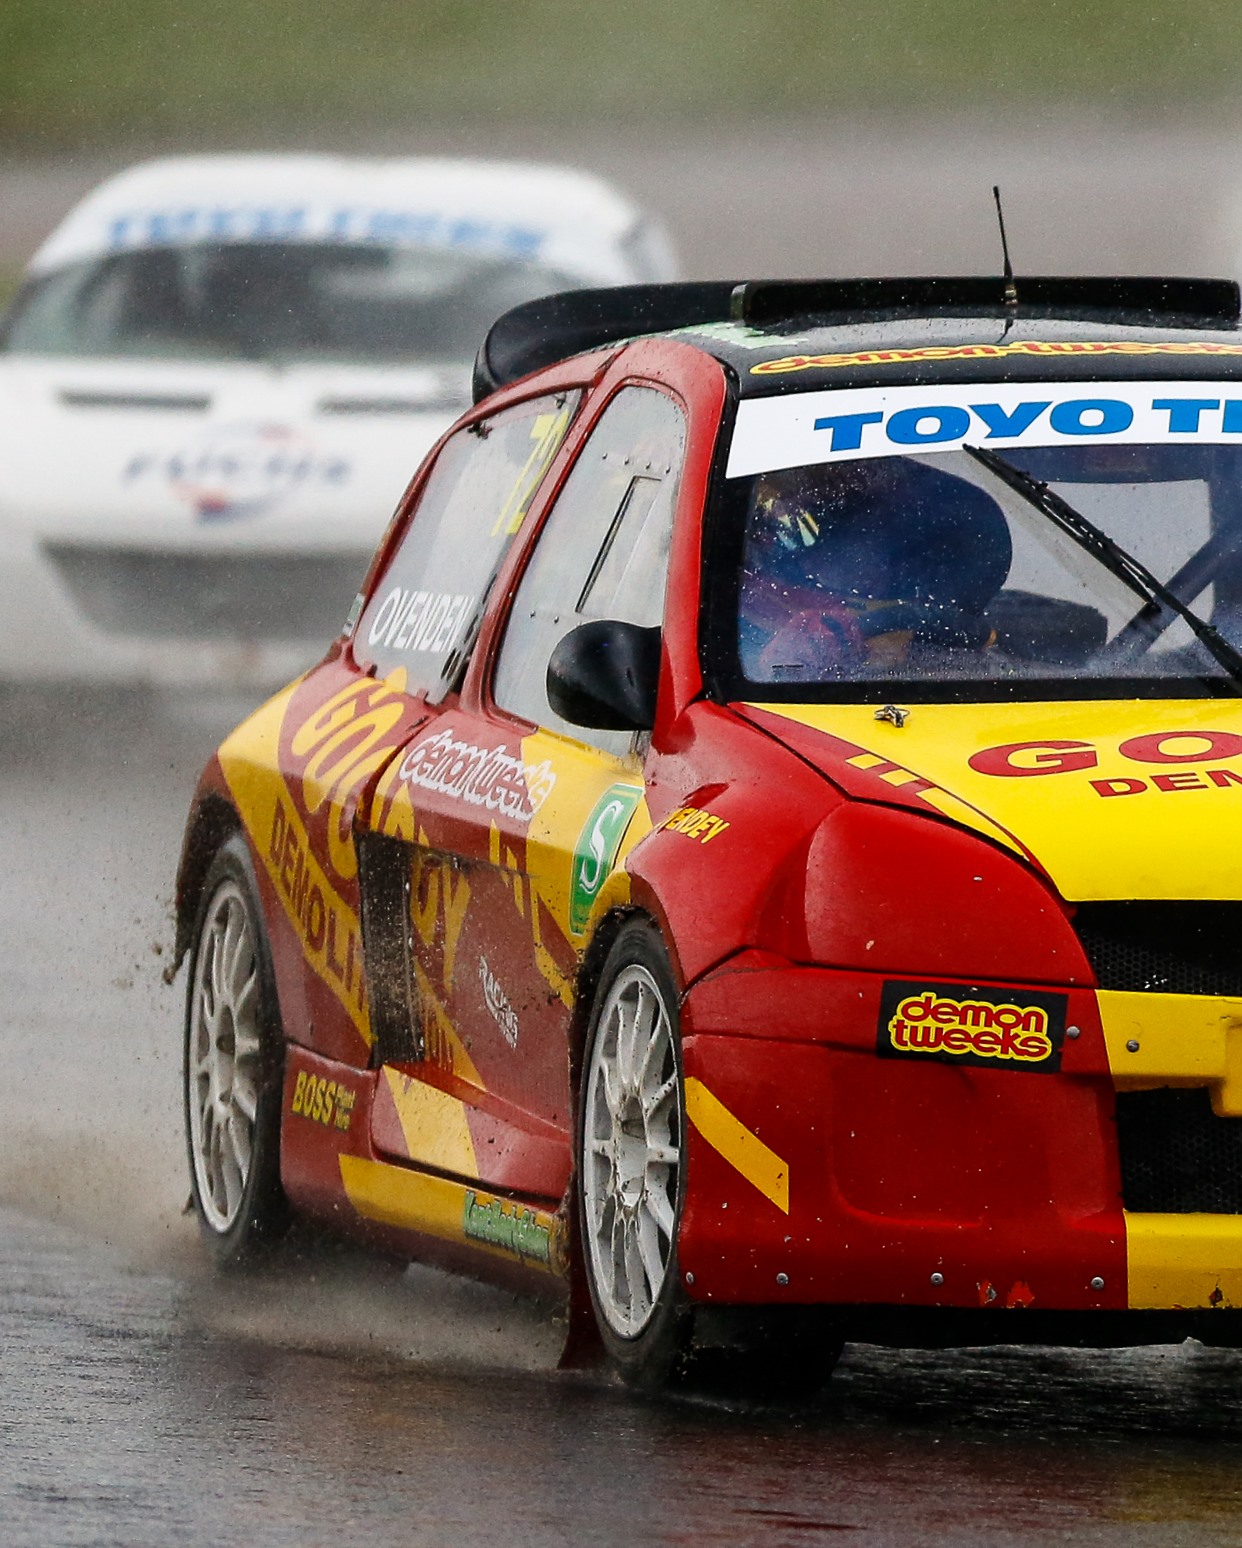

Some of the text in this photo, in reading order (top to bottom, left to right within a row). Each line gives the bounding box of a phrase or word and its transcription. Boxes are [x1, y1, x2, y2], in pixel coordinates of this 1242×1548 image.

[813, 398, 1134, 453] TOYO
[368, 587, 475, 653] OVENDEN
[892, 1018, 1050, 1059] tweeks
[899, 995, 1046, 1034] demon
[292, 1070, 337, 1126] BOSS
